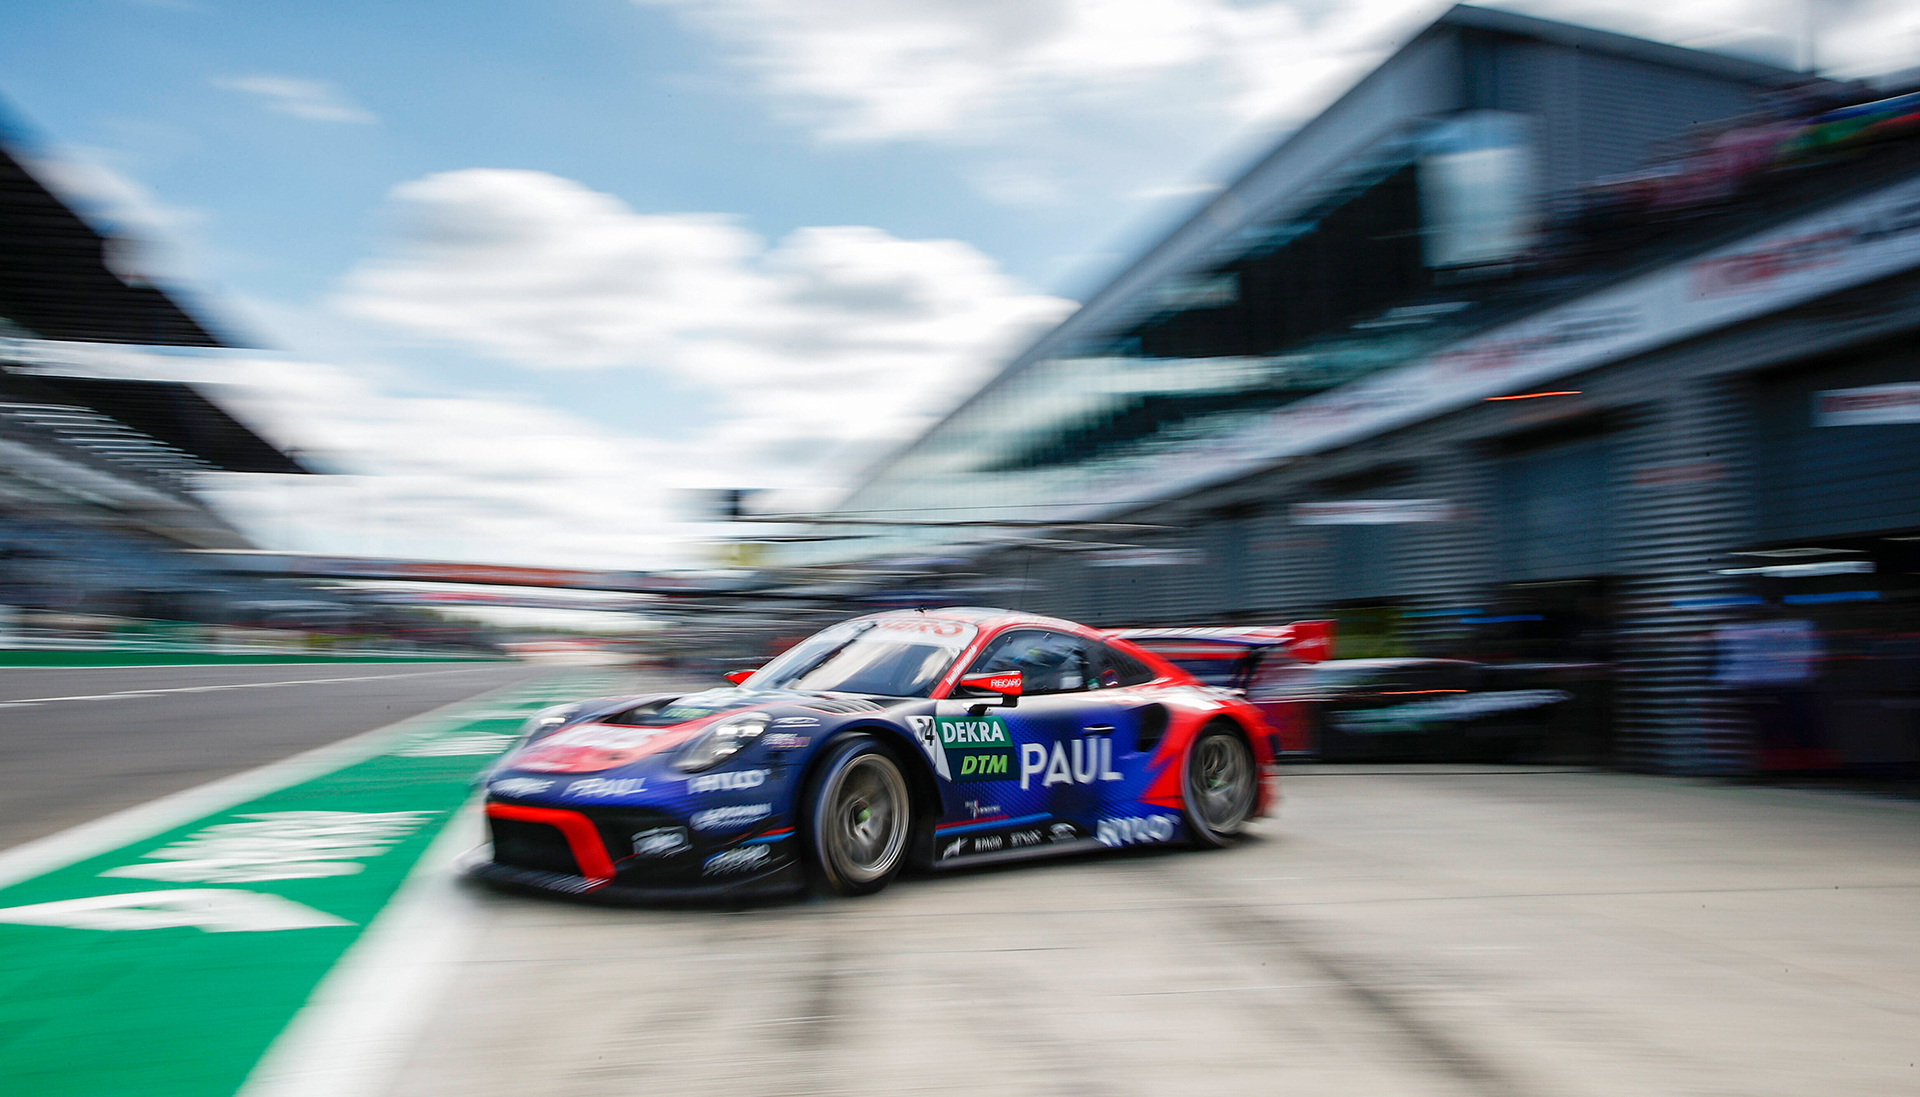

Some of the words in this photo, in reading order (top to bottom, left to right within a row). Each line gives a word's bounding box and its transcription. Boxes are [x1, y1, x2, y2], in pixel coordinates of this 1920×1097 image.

[990, 678, 1022, 688] RECARO
[941, 721, 1005, 743] DEKRA
[961, 754, 1008, 775] DTM
[1020, 738, 1124, 790] PAUL
